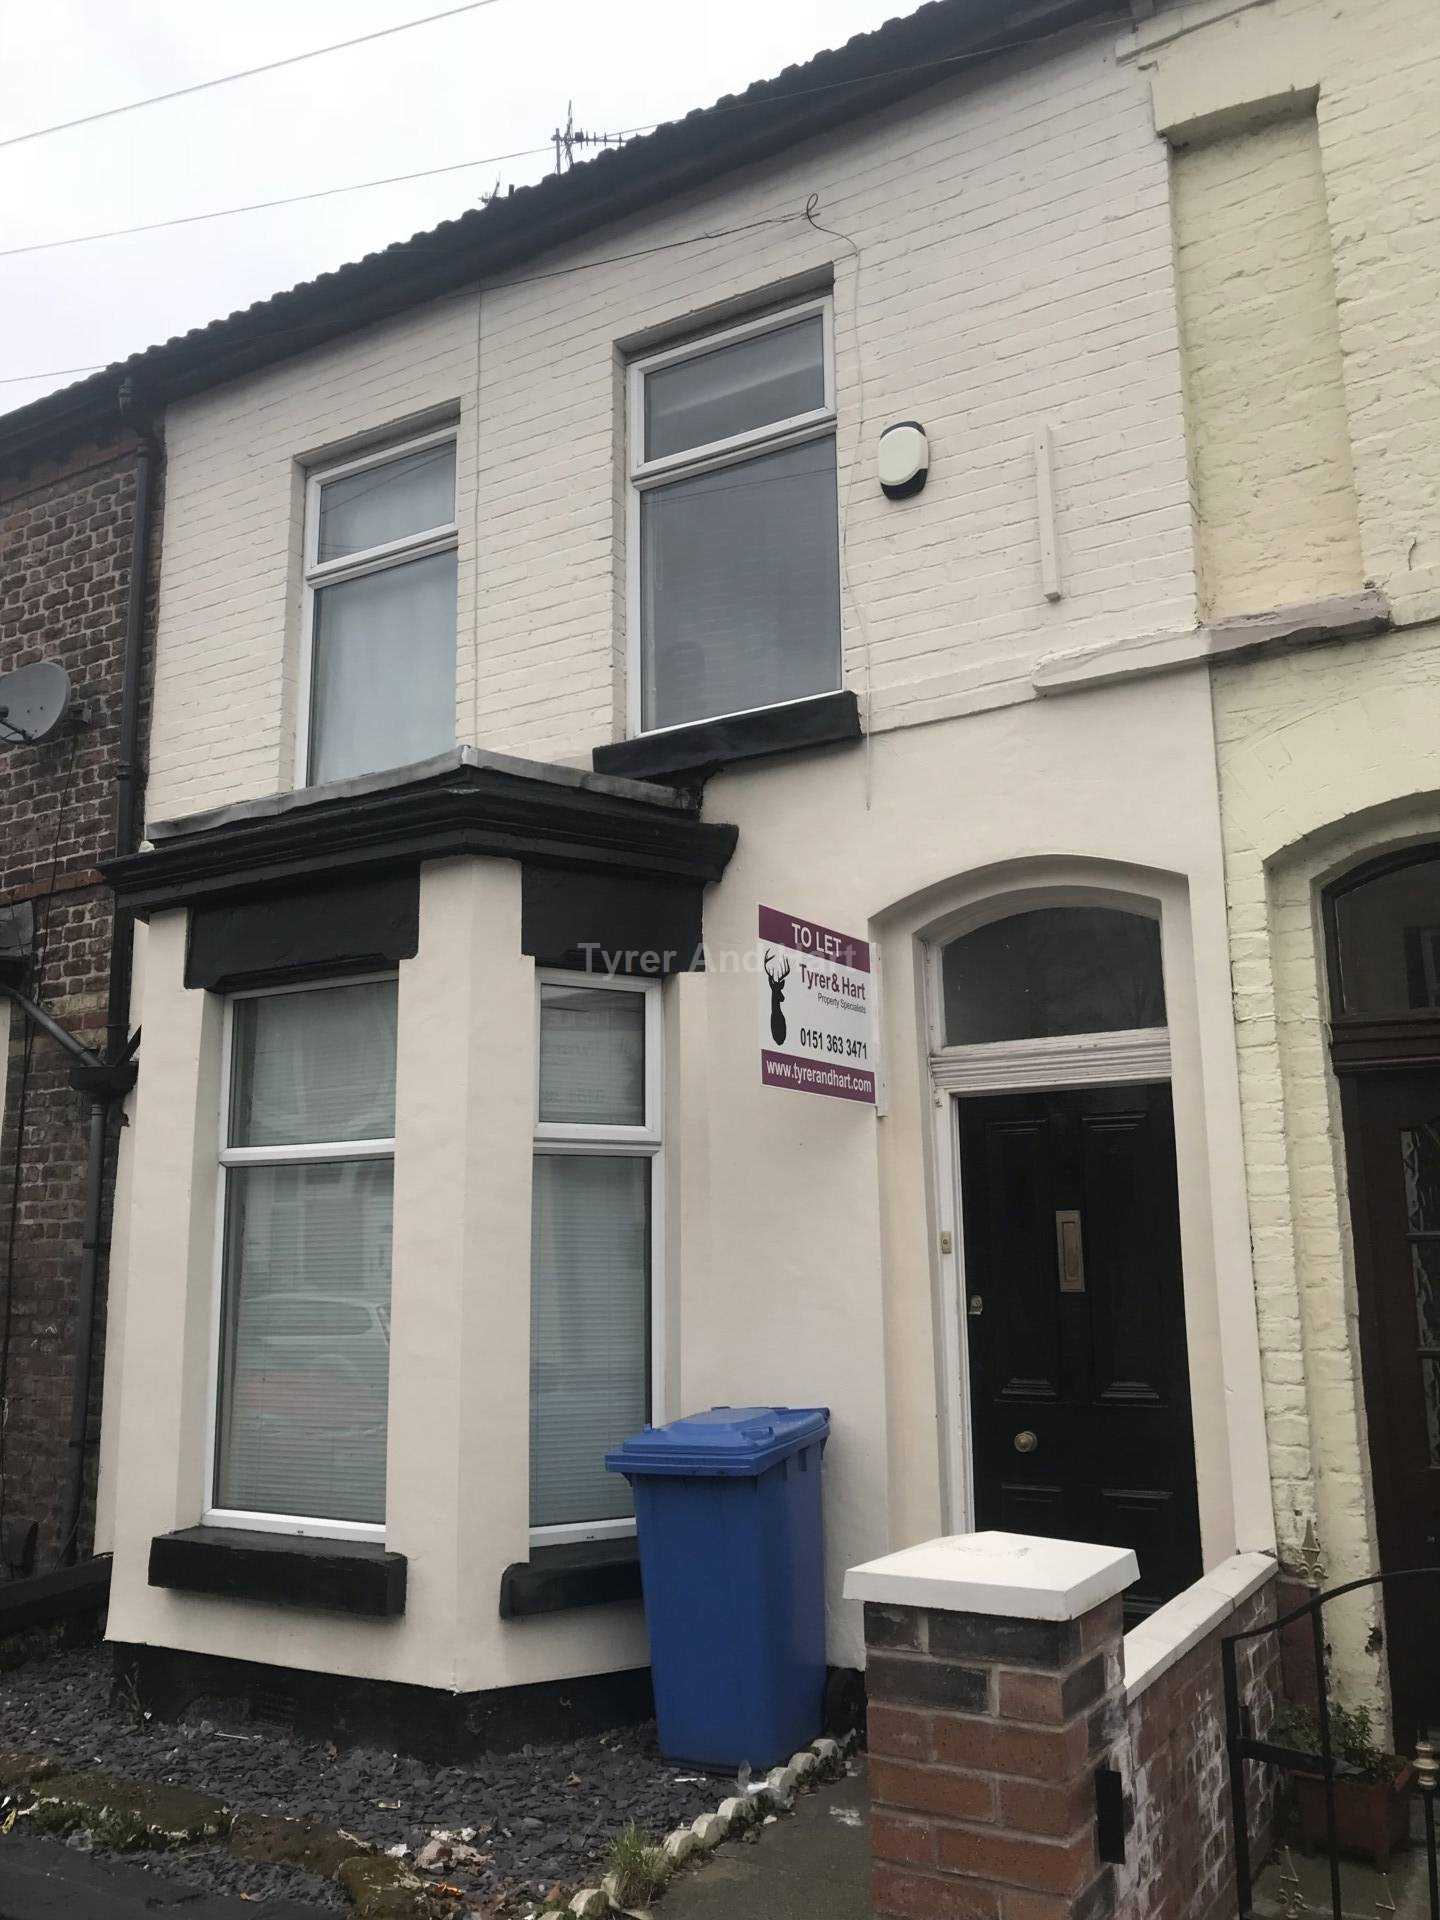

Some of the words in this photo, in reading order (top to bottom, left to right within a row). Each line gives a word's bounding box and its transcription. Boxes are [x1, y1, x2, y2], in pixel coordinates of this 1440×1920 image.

[791, 923, 812, 946] TO
[816, 931, 842, 957] LET
[817, 993, 840, 1009] Property
[841, 976, 866, 1001] Hart
[800, 1027, 823, 1051] 0151
[826, 1034, 844, 1055] 363
[846, 1039, 867, 1060] 3471
[766, 1059, 872, 1093] www.tyrerandhart.com
